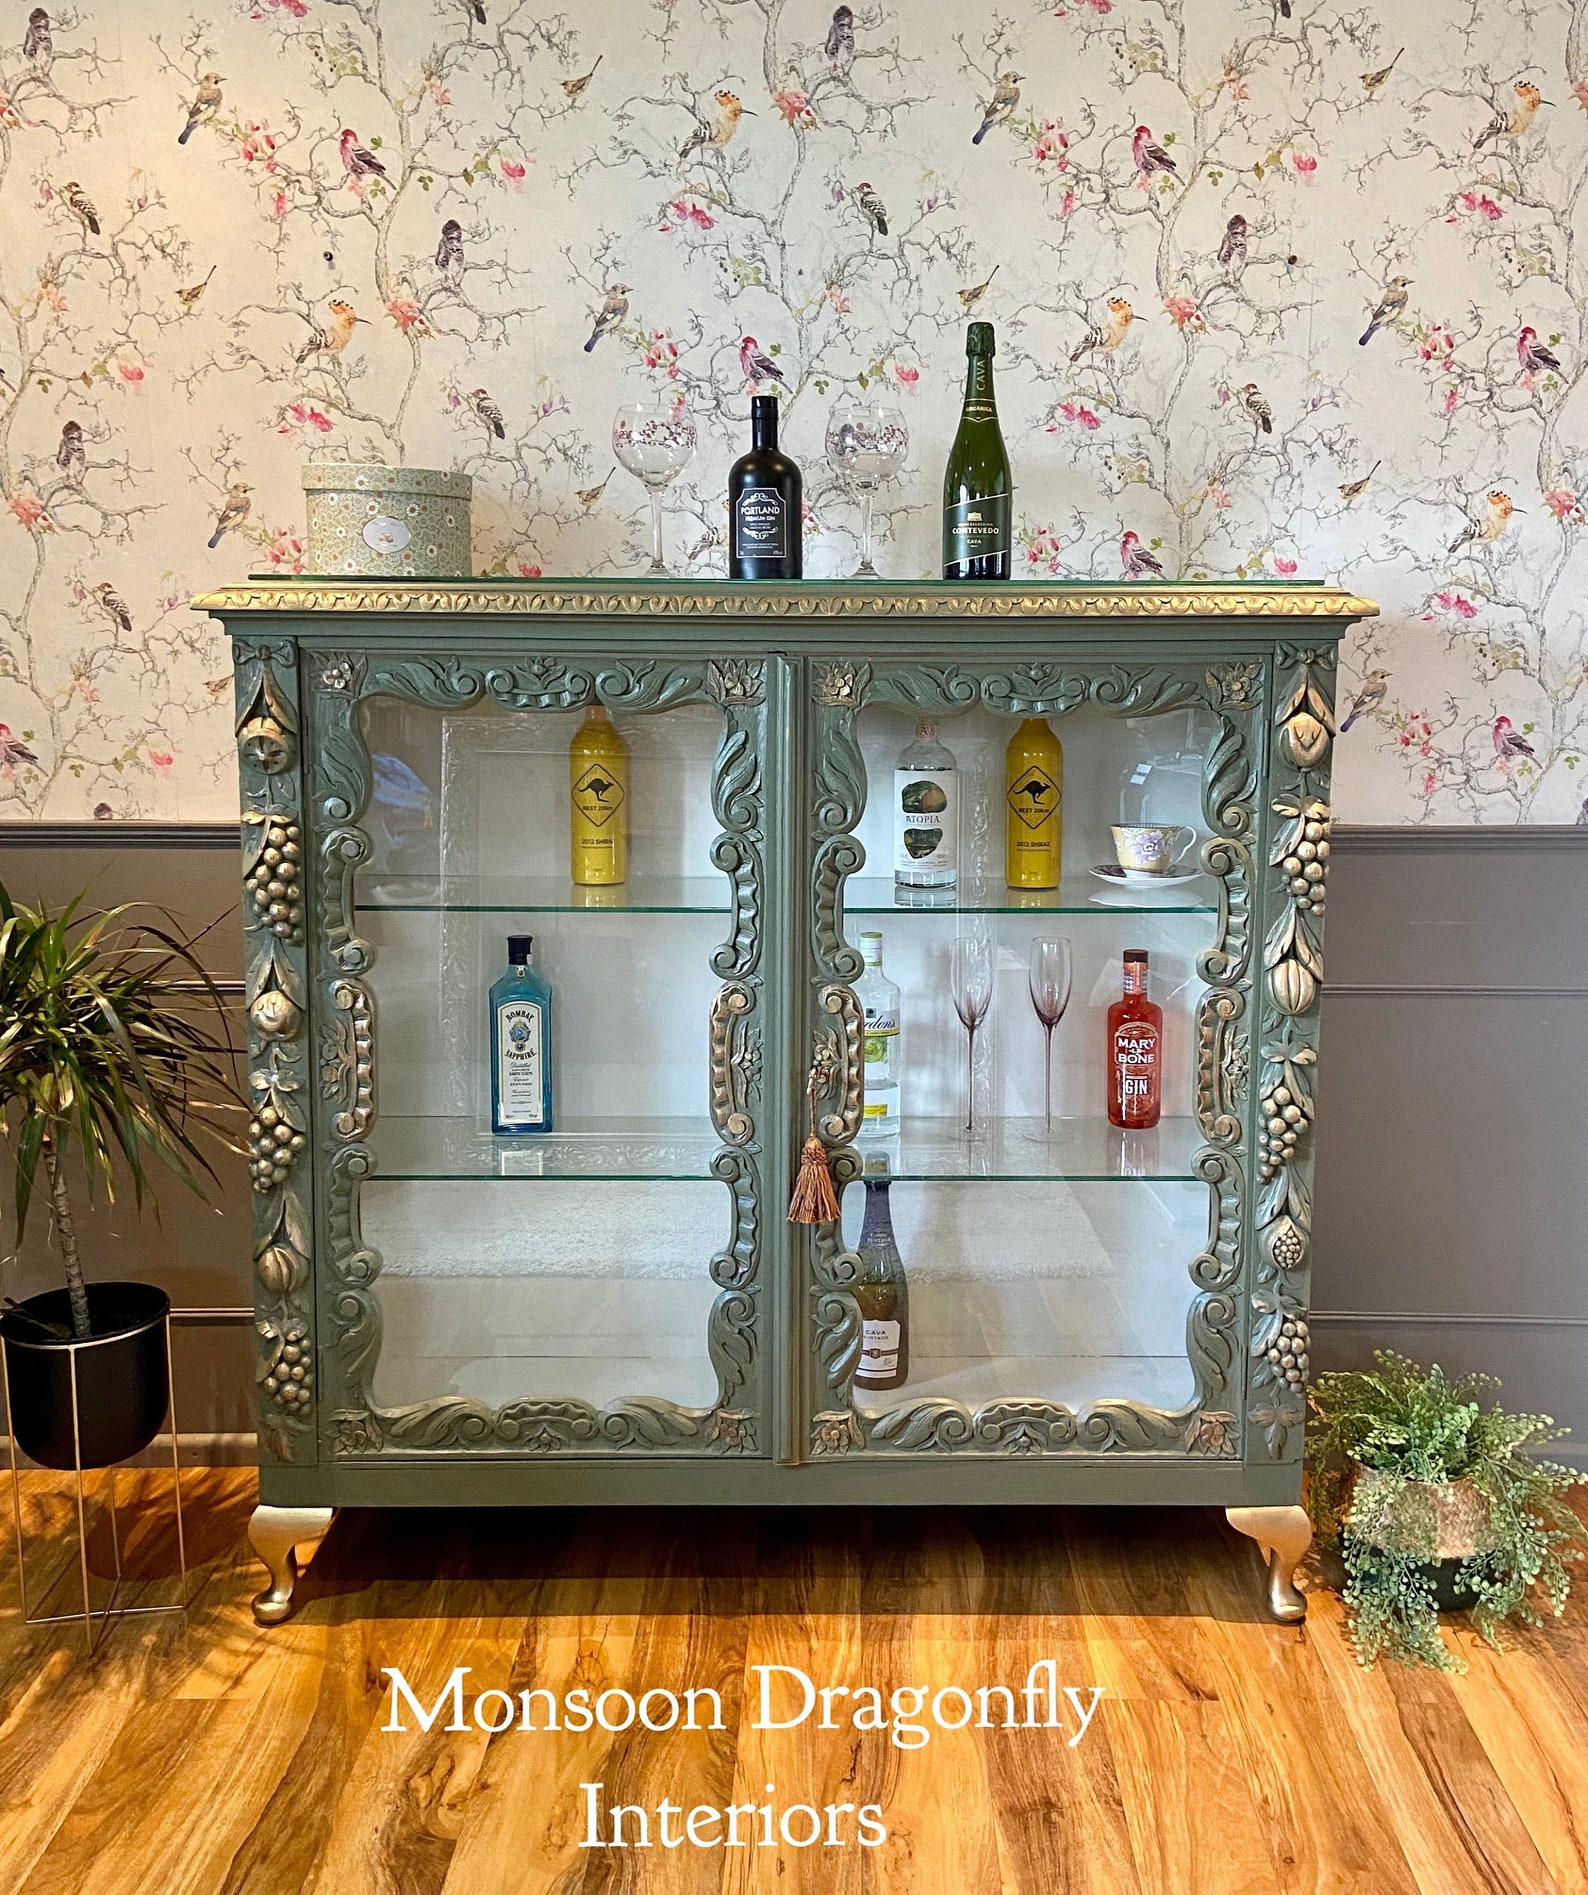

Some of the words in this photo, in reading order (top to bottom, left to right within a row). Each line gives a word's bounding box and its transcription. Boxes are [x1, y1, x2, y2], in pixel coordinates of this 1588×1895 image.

[976, 359, 985, 391] CAVA
[740, 506, 780, 515] PORTLAND
[952, 527, 999, 535] CONTEVEDO
[905, 815, 940, 823] ATOPIA
[505, 1010, 535, 1023] BOMBAY
[864, 1014, 896, 1029] rdon's
[1118, 1037, 1155, 1049] MARY
[504, 1047, 537, 1061] SAPPHIRE
[1118, 1053, 1155, 1064] BONE
[1125, 1079, 1148, 1095] GIN
